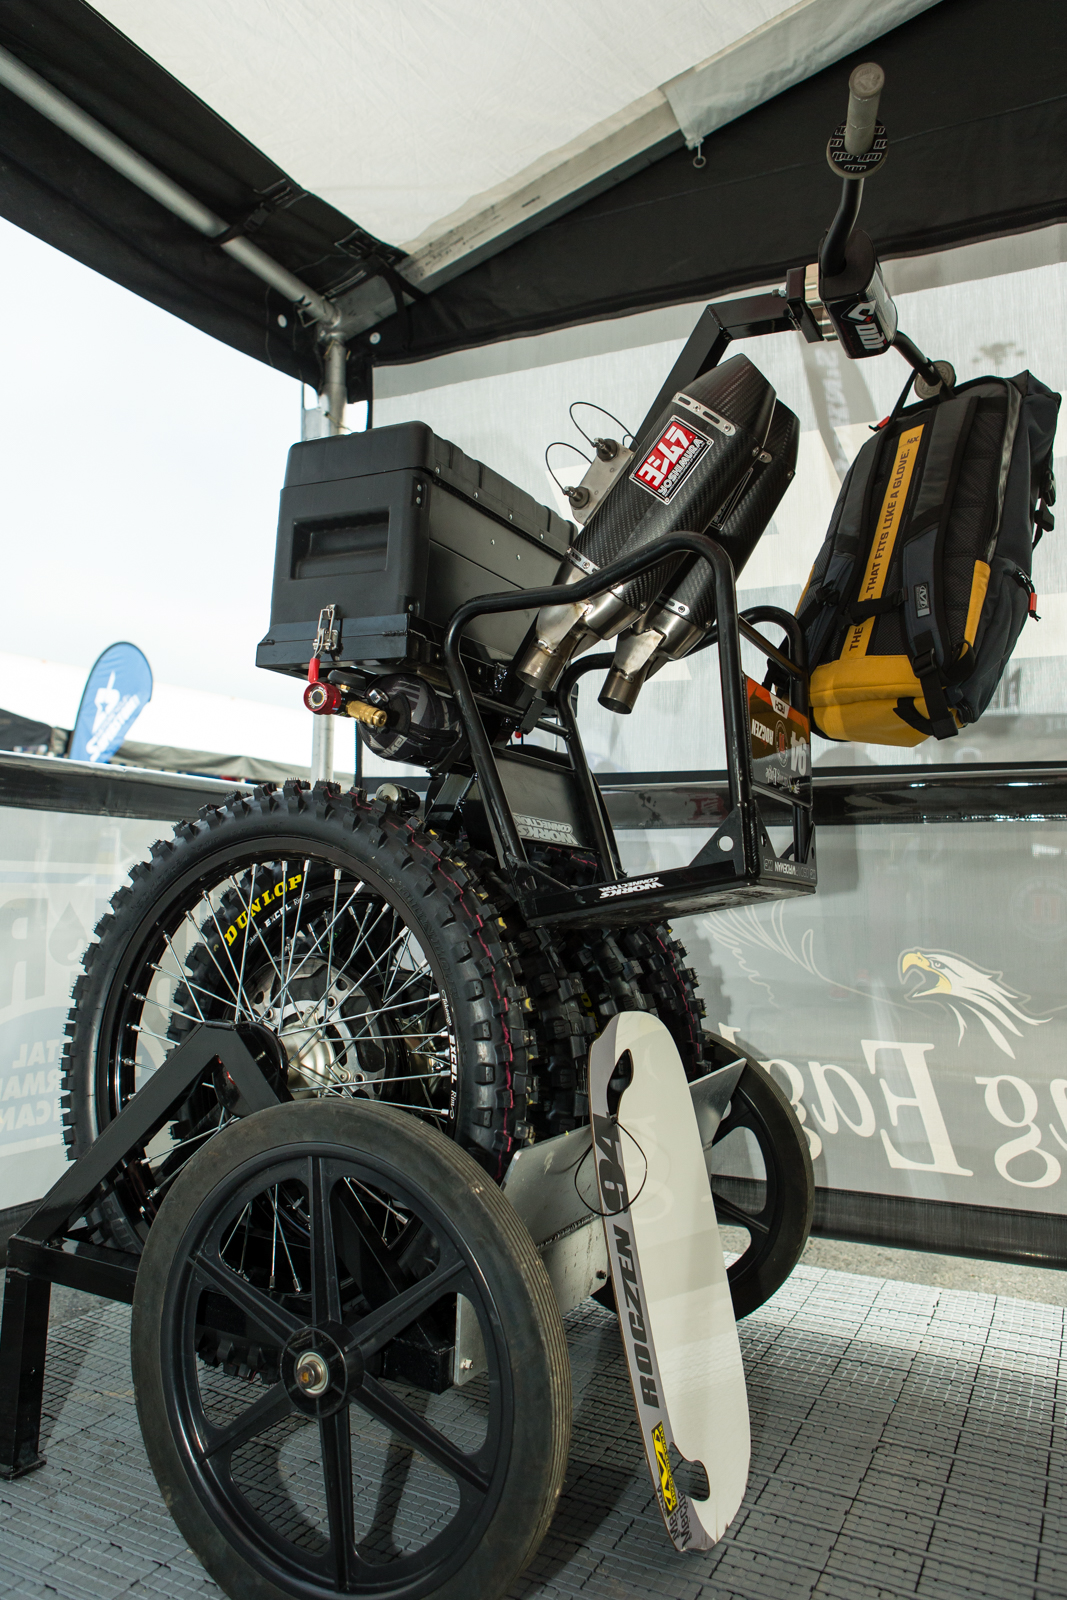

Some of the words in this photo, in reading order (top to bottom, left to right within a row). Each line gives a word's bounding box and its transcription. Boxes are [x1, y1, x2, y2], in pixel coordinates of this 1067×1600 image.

[657, 437, 705, 496] YOSHIMURA
[849, 626, 864, 652] THE
[865, 563, 881, 596] THAT
[874, 531, 890, 561] FITS
[882, 501, 897, 530] LIKE
[890, 489, 900, 499] A
[751, 718, 775, 746] ROCZEN
[790, 730, 807, 777] 94
[513, 815, 571, 832] CONNECTION
[517, 825, 579, 845] WORKS
[598, 876, 660, 892] CONNECTION
[599, 882, 665, 899] WORKS
[223, 873, 303, 947] DUNLOP
[449, 1034, 458, 1084] EXCEL
[593, 1112, 629, 1214] 94
[612, 1224, 661, 1409] ROCZEN
